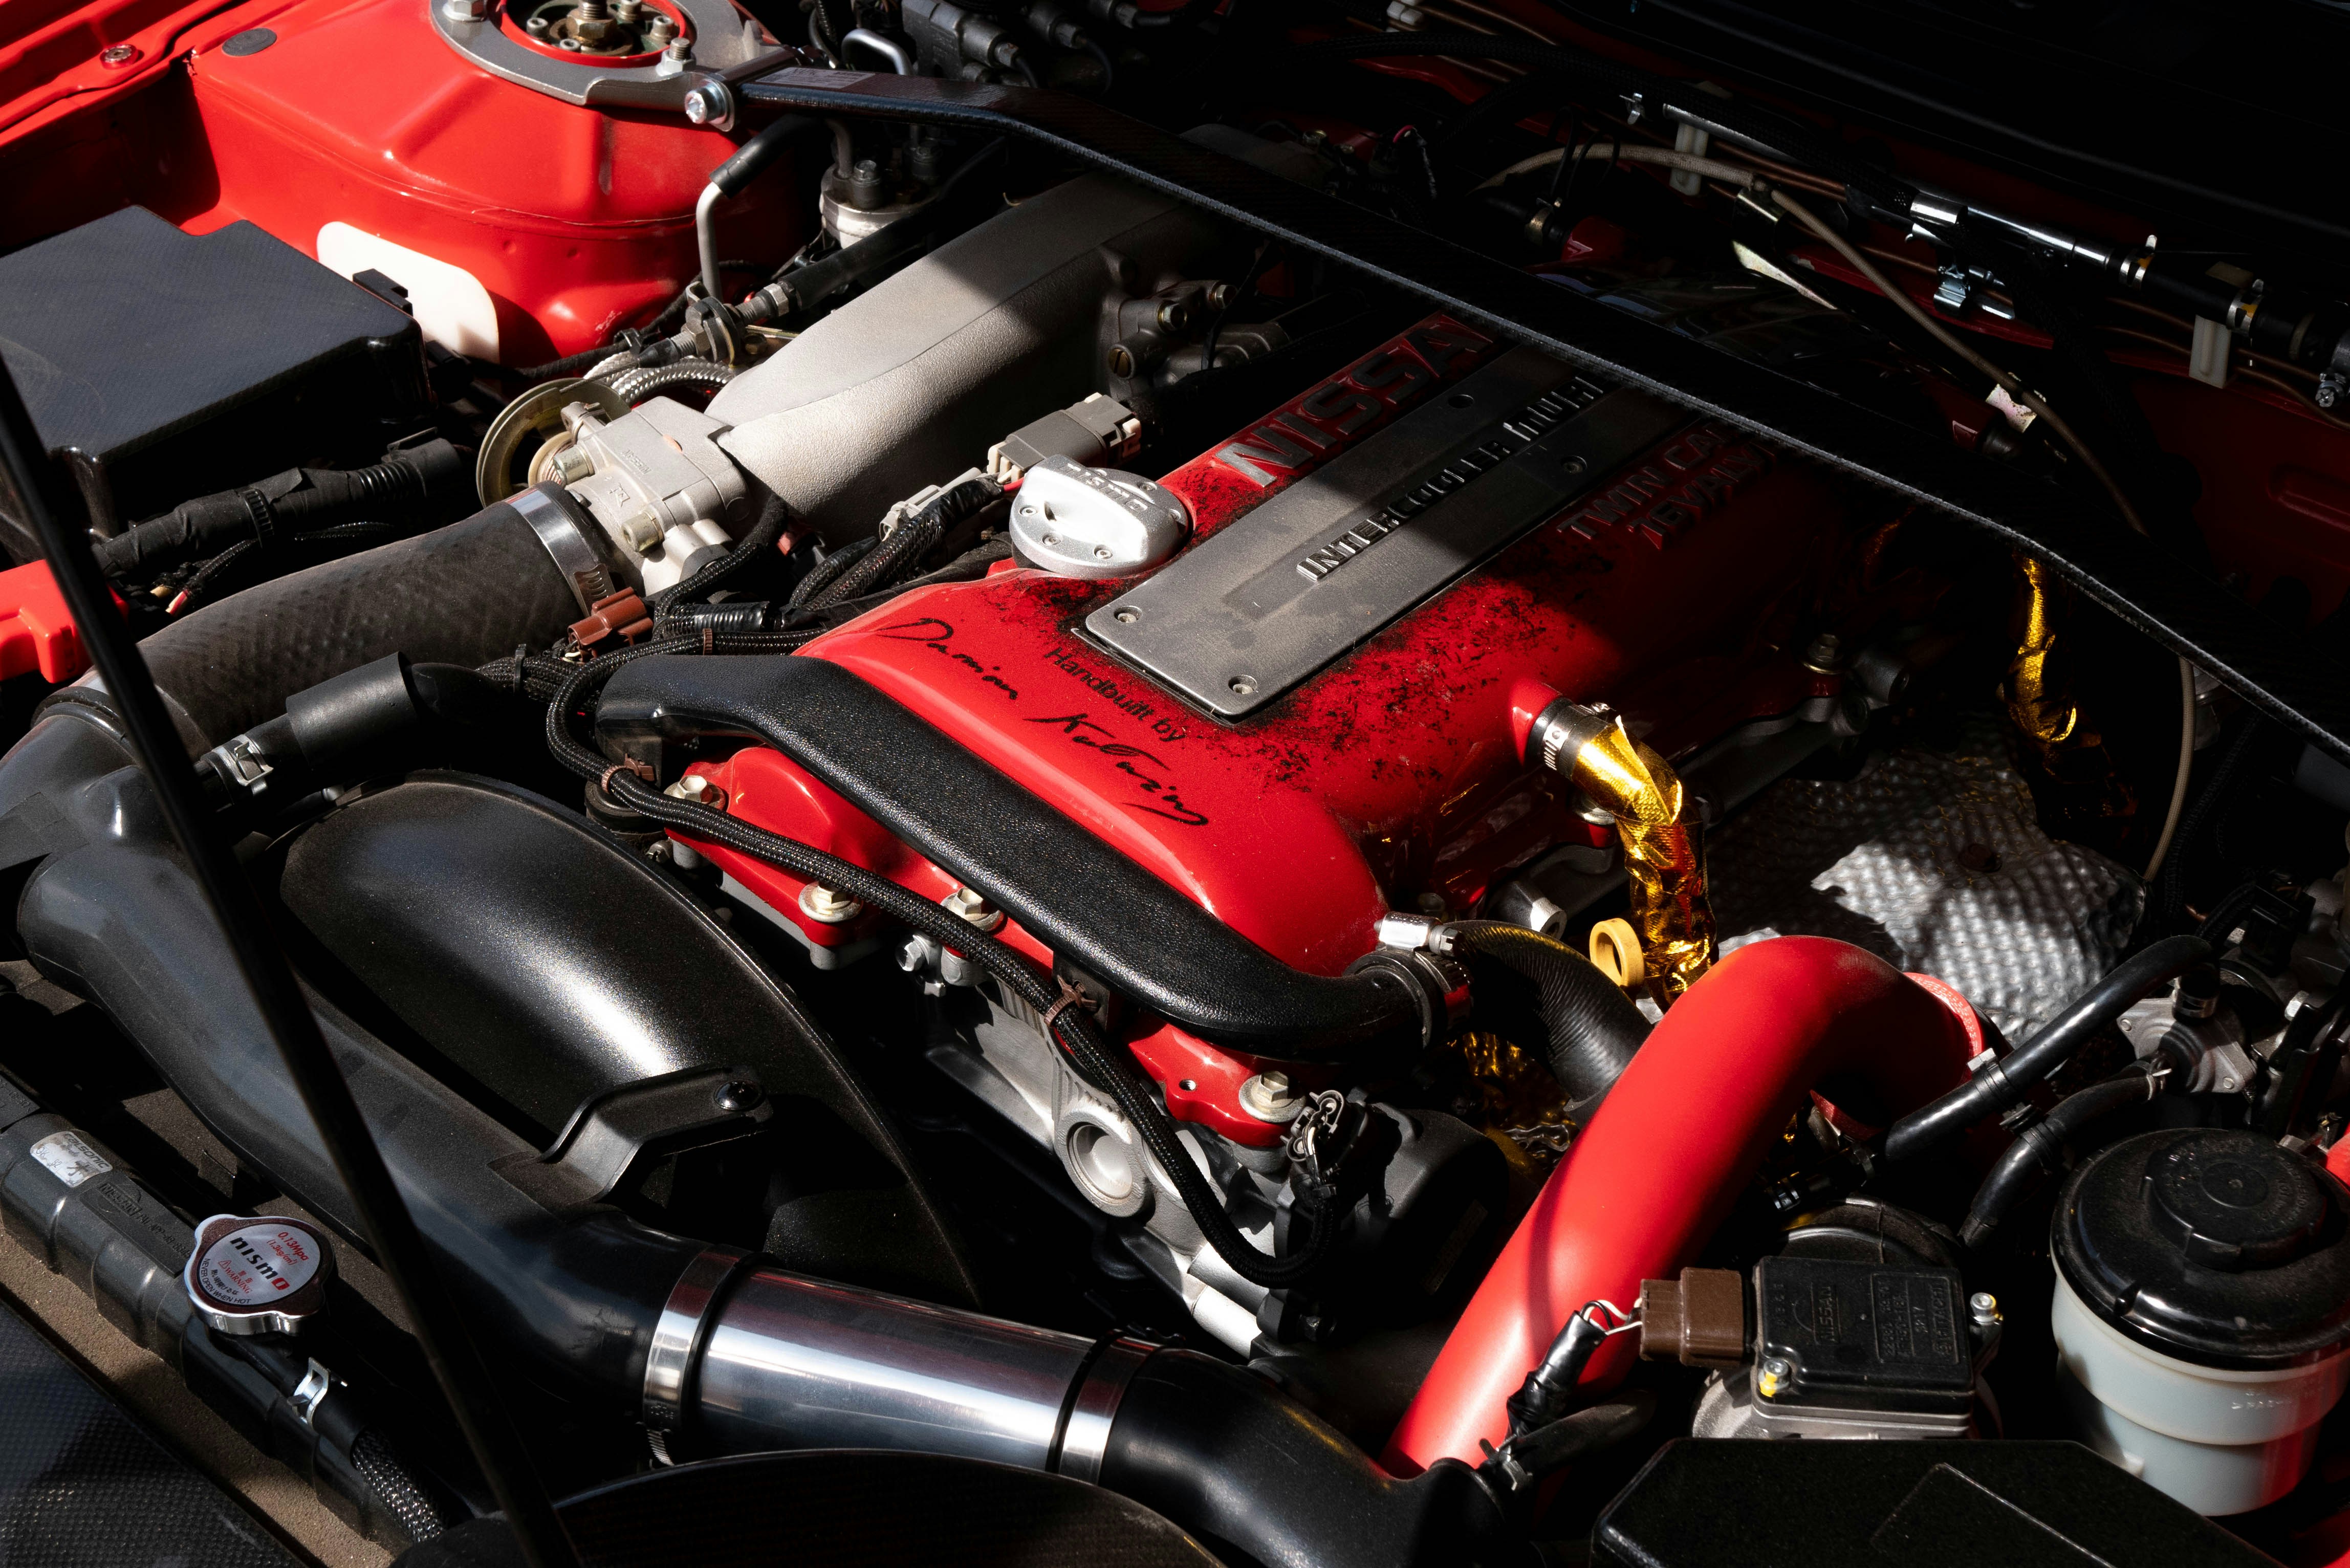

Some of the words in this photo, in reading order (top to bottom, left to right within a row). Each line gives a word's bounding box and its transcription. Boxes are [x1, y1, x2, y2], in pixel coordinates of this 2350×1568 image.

[1215, 313, 1497, 487] NISSA
[1295, 439, 1512, 582] INTERCOOLER
[1503, 375, 1608, 442] TUR
[1555, 466, 1673, 540] TWIN
[1044, 647, 1155, 721] Handbuilt
[1151, 717, 1187, 742] by
[230, 1237, 290, 1291] nismo
[277, 1232, 309, 1261] 0.13Mpa
[200, 1258, 210, 1278] NEVER
[202, 1277, 215, 1293] OPEN
[225, 1267, 252, 1294] WARNING
[212, 1289, 233, 1303] WHEN
